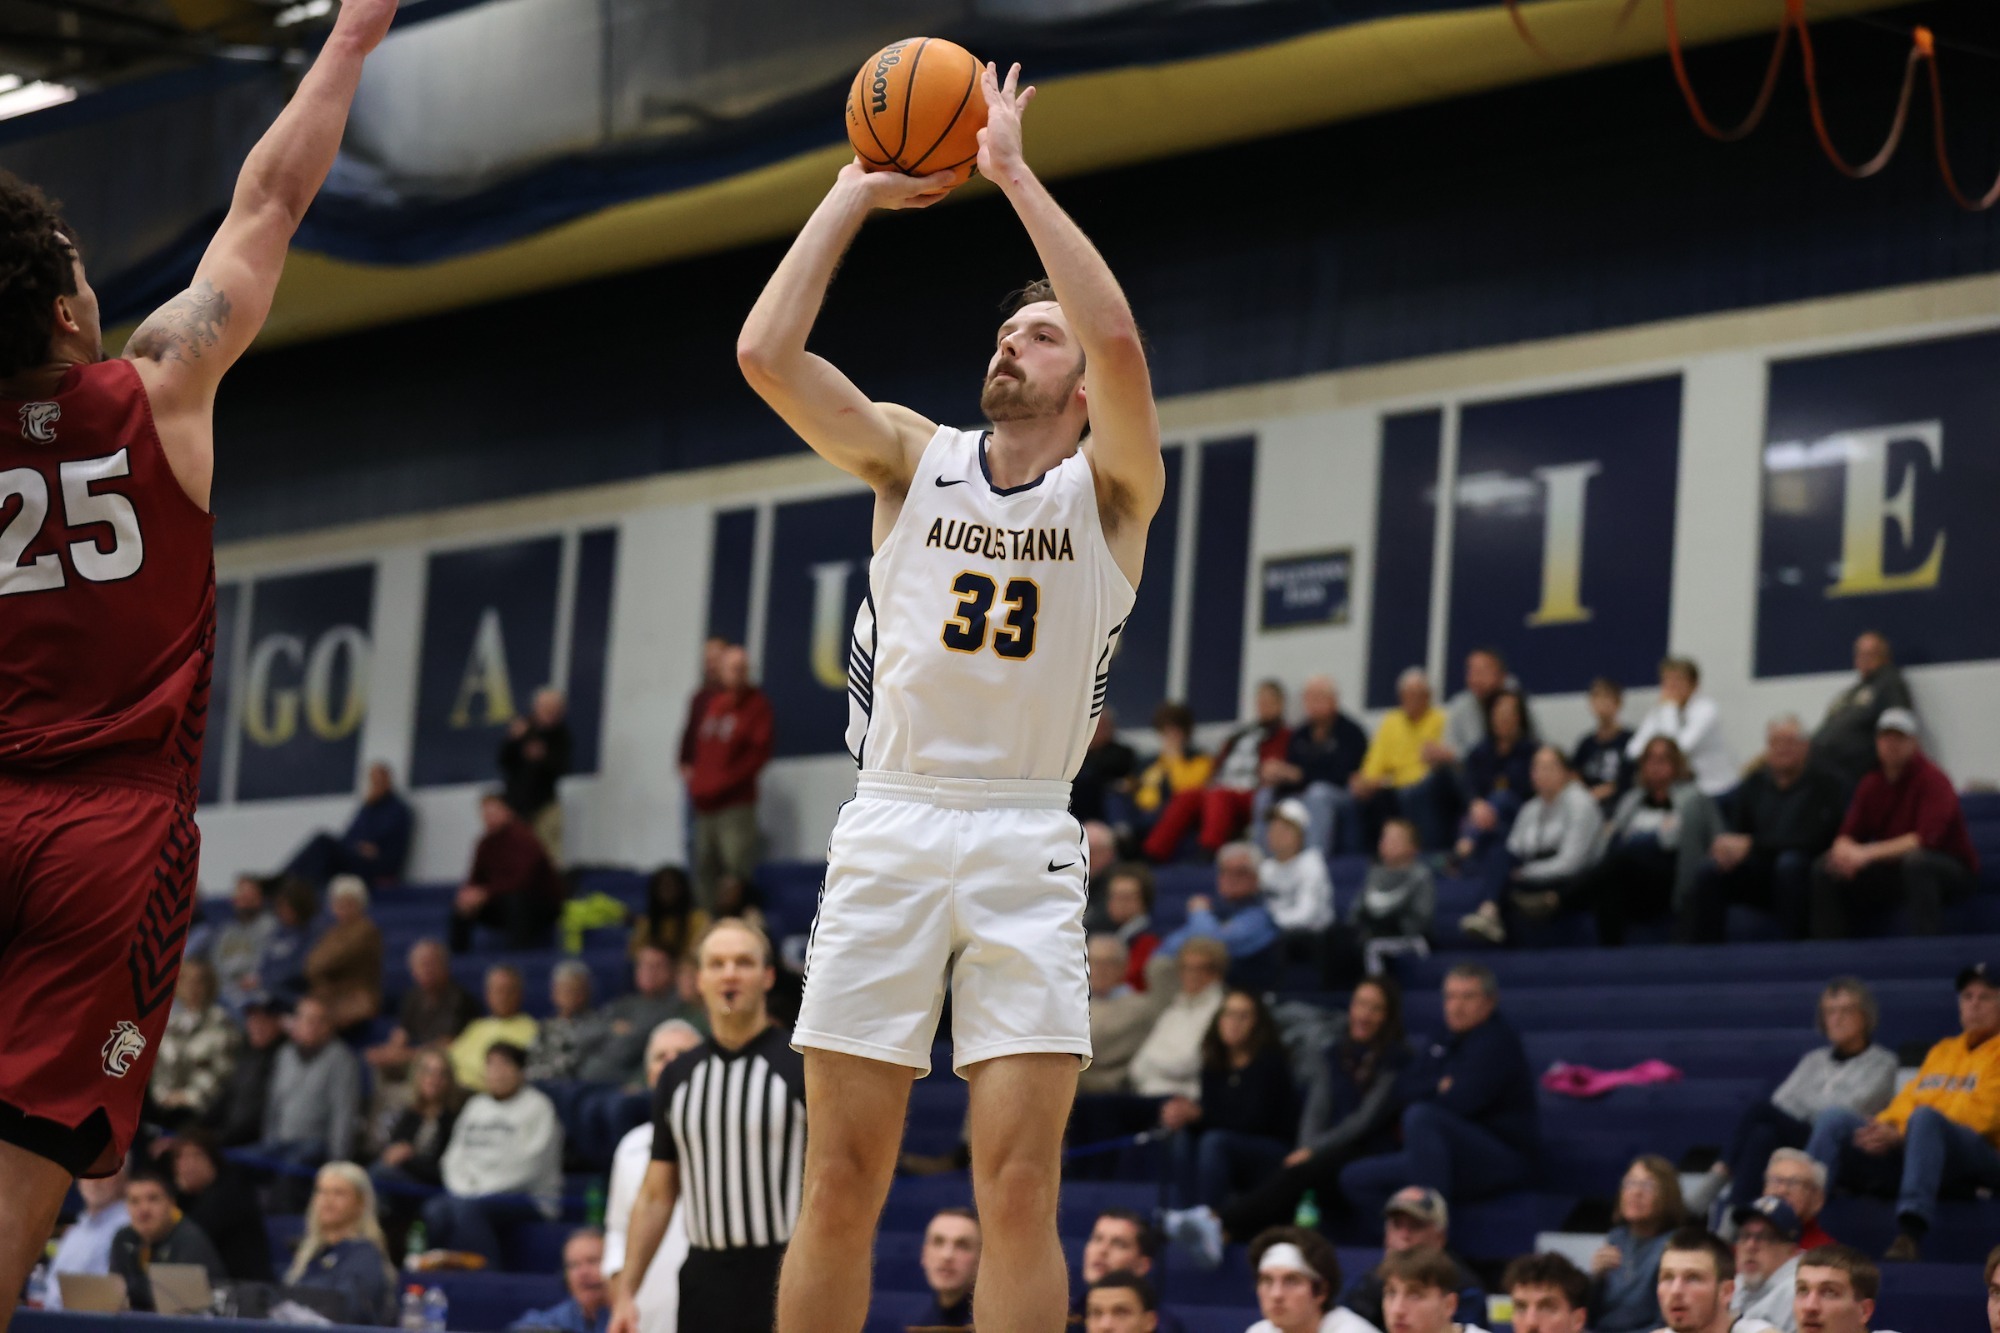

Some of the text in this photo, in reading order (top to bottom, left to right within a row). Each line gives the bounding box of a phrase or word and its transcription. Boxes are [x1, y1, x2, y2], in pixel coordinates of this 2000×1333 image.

[0, 448, 143, 595] 25
[926, 517, 1074, 561] AUGUSTANA
[245, 624, 372, 747] GO
[449, 606, 516, 728] A
[1824, 418, 1945, 599] E
[940, 569, 1040, 661] 33
